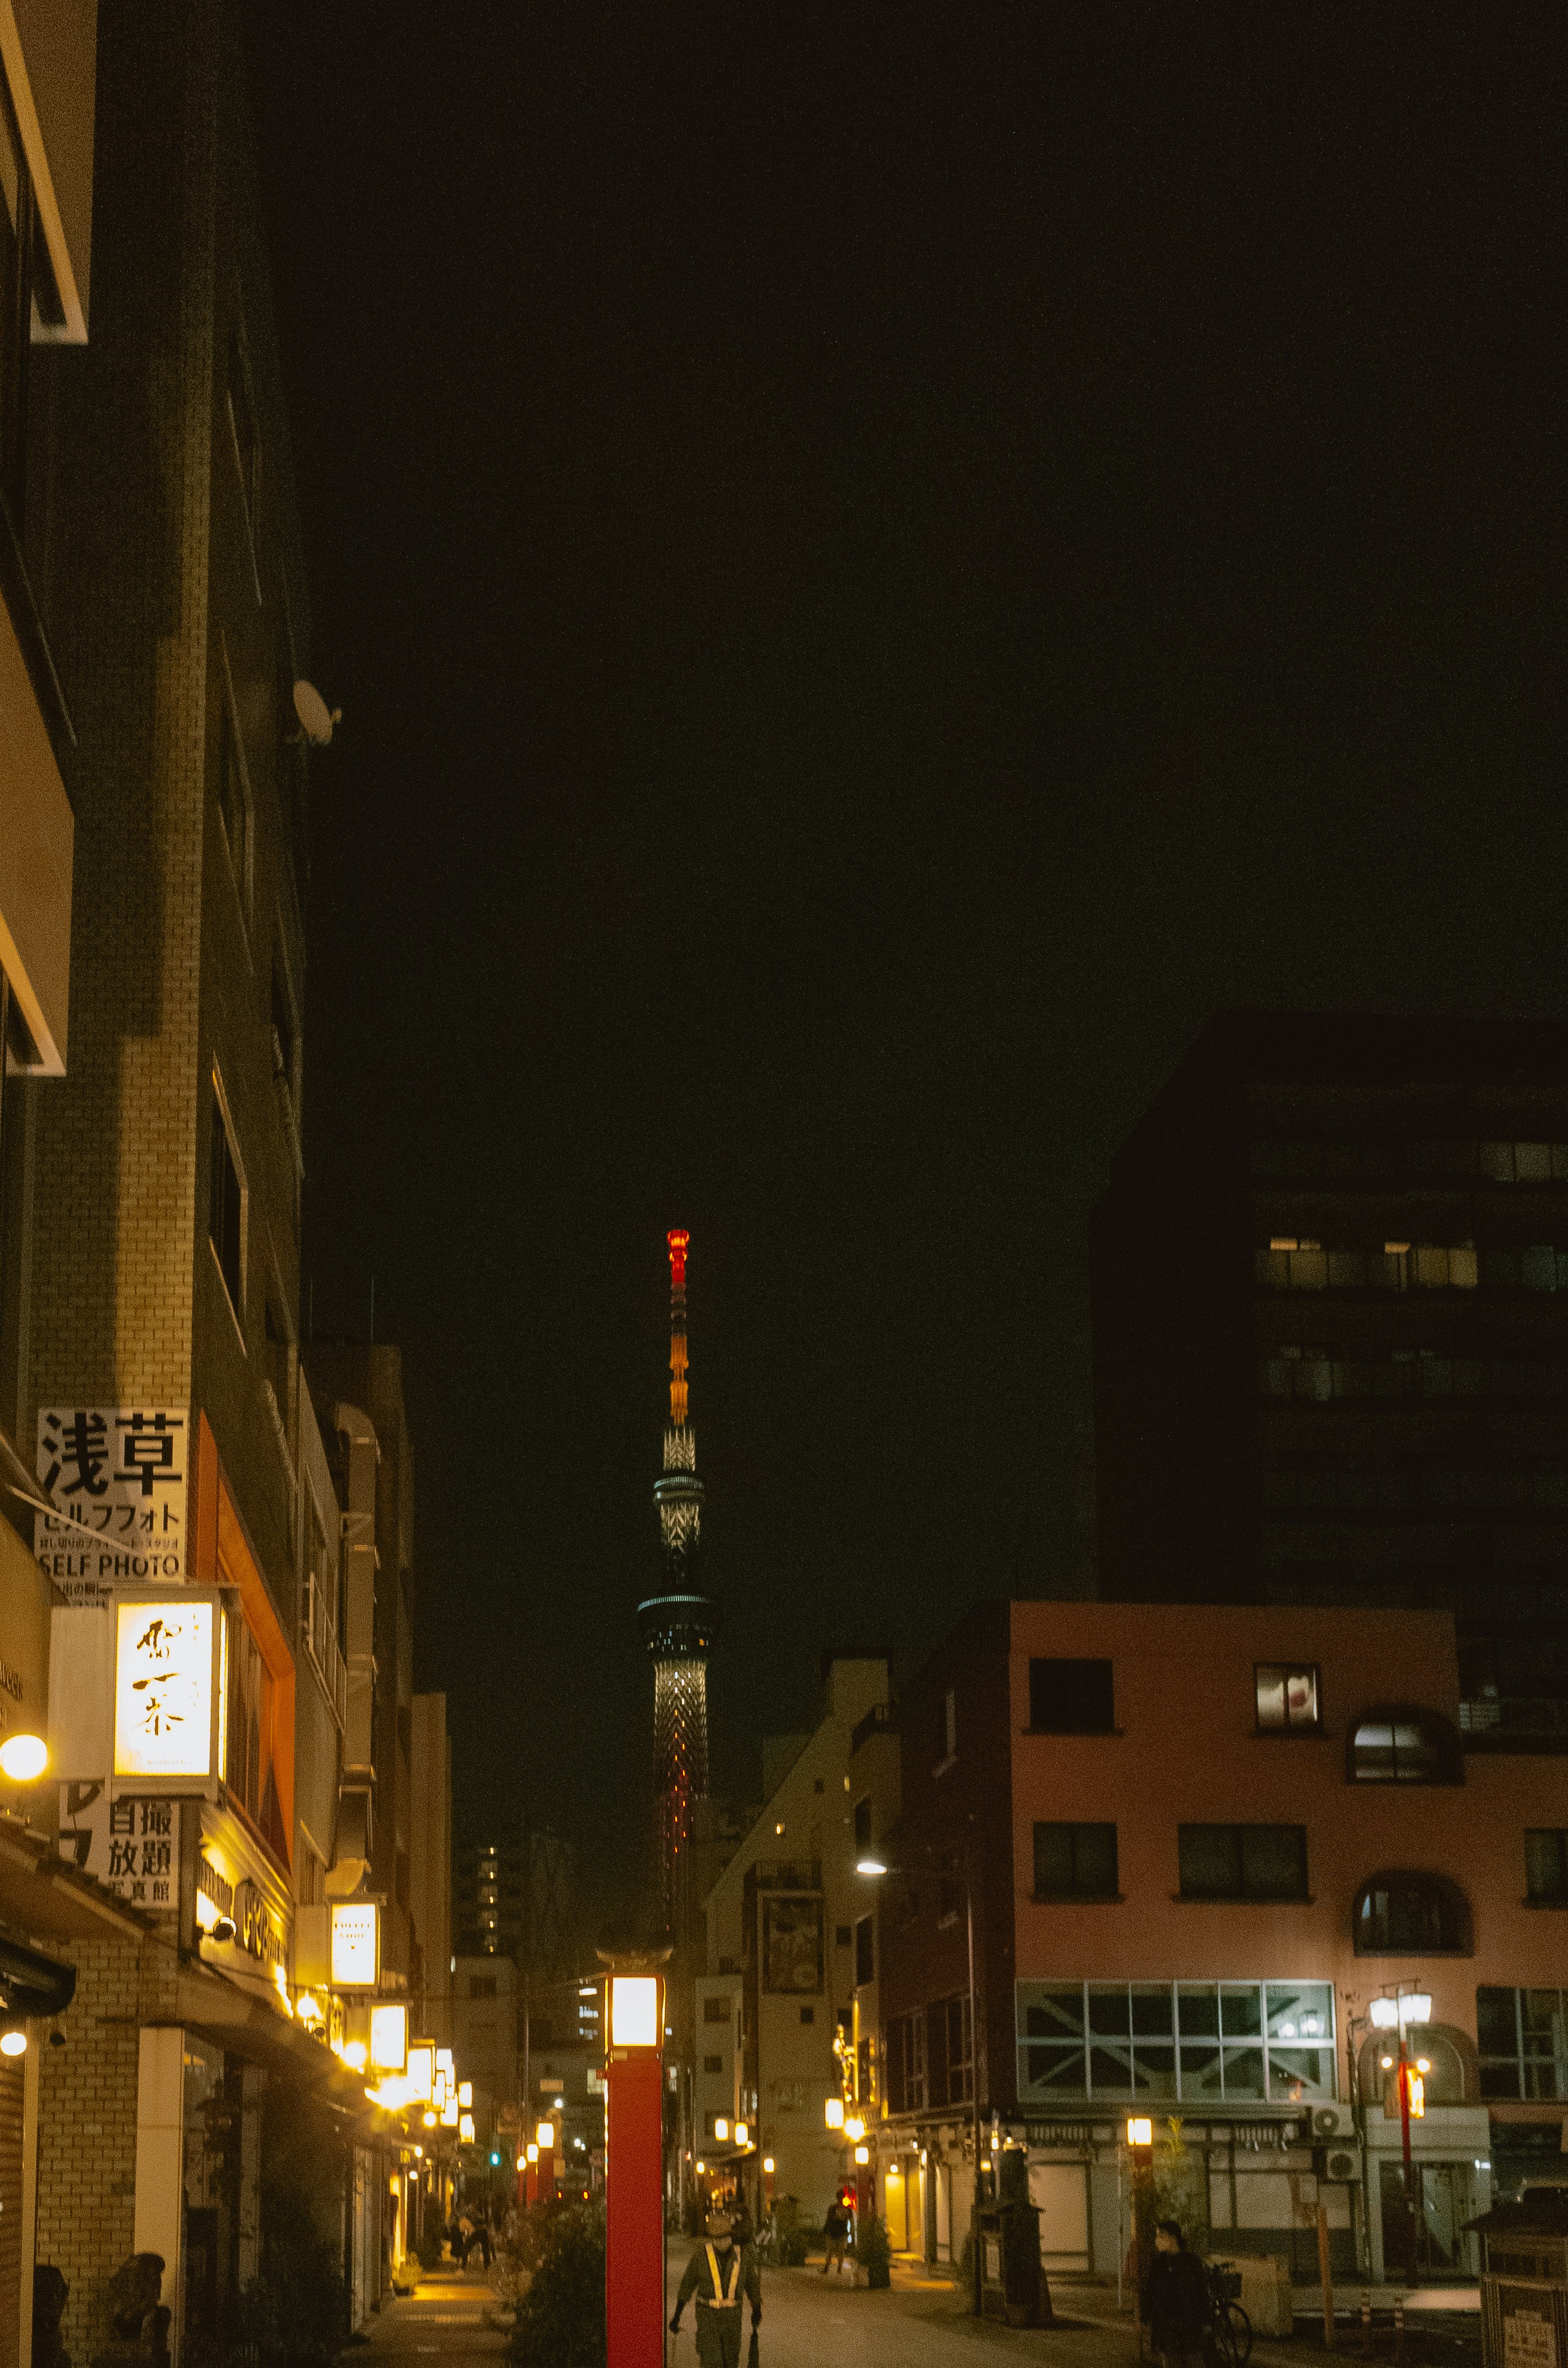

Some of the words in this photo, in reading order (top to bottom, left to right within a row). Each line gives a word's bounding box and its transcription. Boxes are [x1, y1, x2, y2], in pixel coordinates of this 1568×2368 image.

[43, 1412, 184, 1496] 浅草
[39, 1554, 91, 1577] SELF
[99, 1554, 180, 1577] PHOTO
[108, 1839, 171, 1876] 放題
